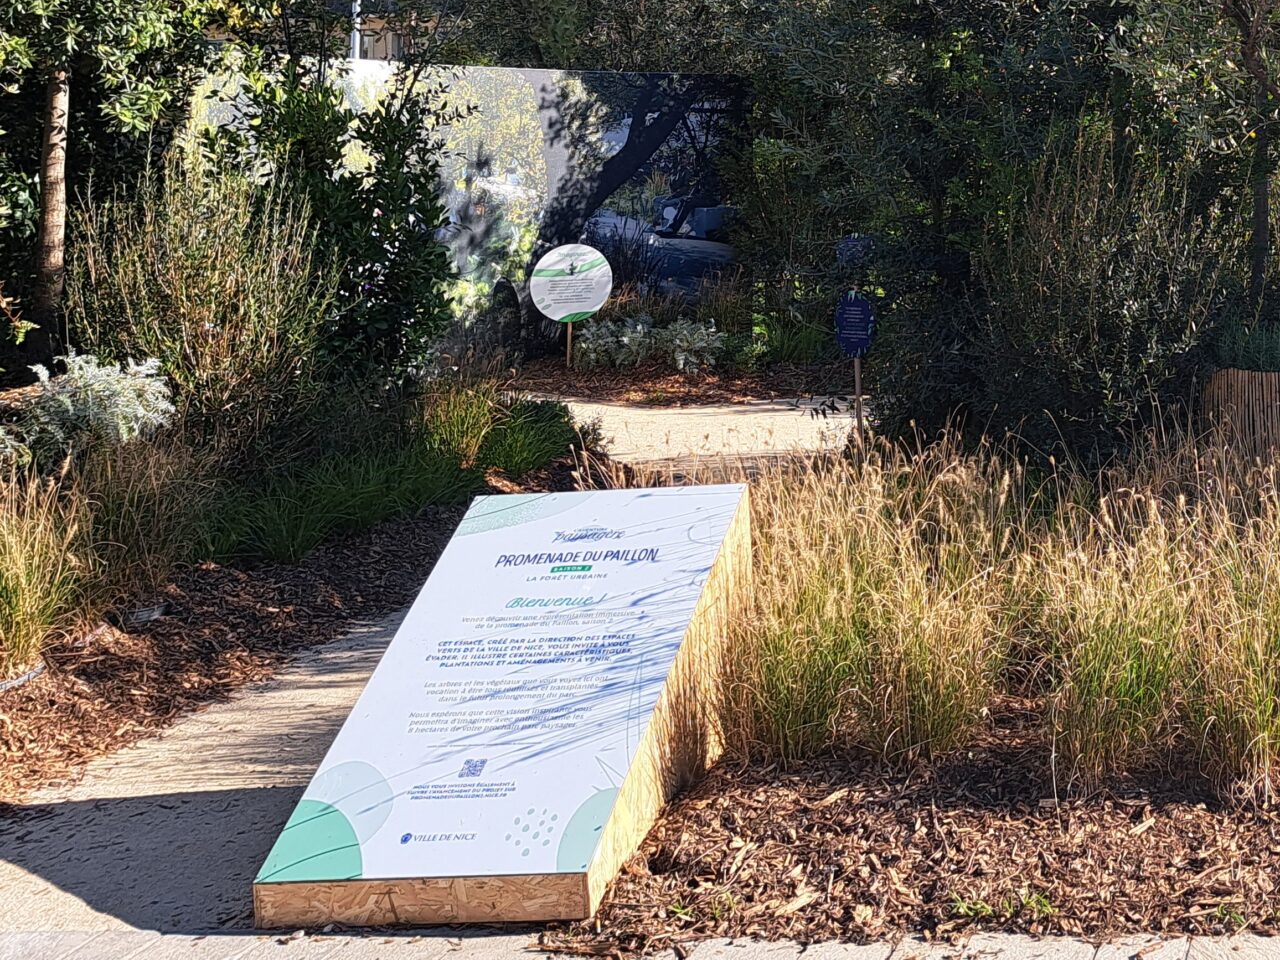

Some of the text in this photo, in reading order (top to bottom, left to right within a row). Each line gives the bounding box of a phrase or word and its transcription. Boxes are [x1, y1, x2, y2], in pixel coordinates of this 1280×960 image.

[495, 548, 659, 568] PROMENADE DU PAILLON
[505, 596, 594, 608] Bienvenue
[413, 834, 437, 842] VILLE
[454, 833, 477, 841] NICE
